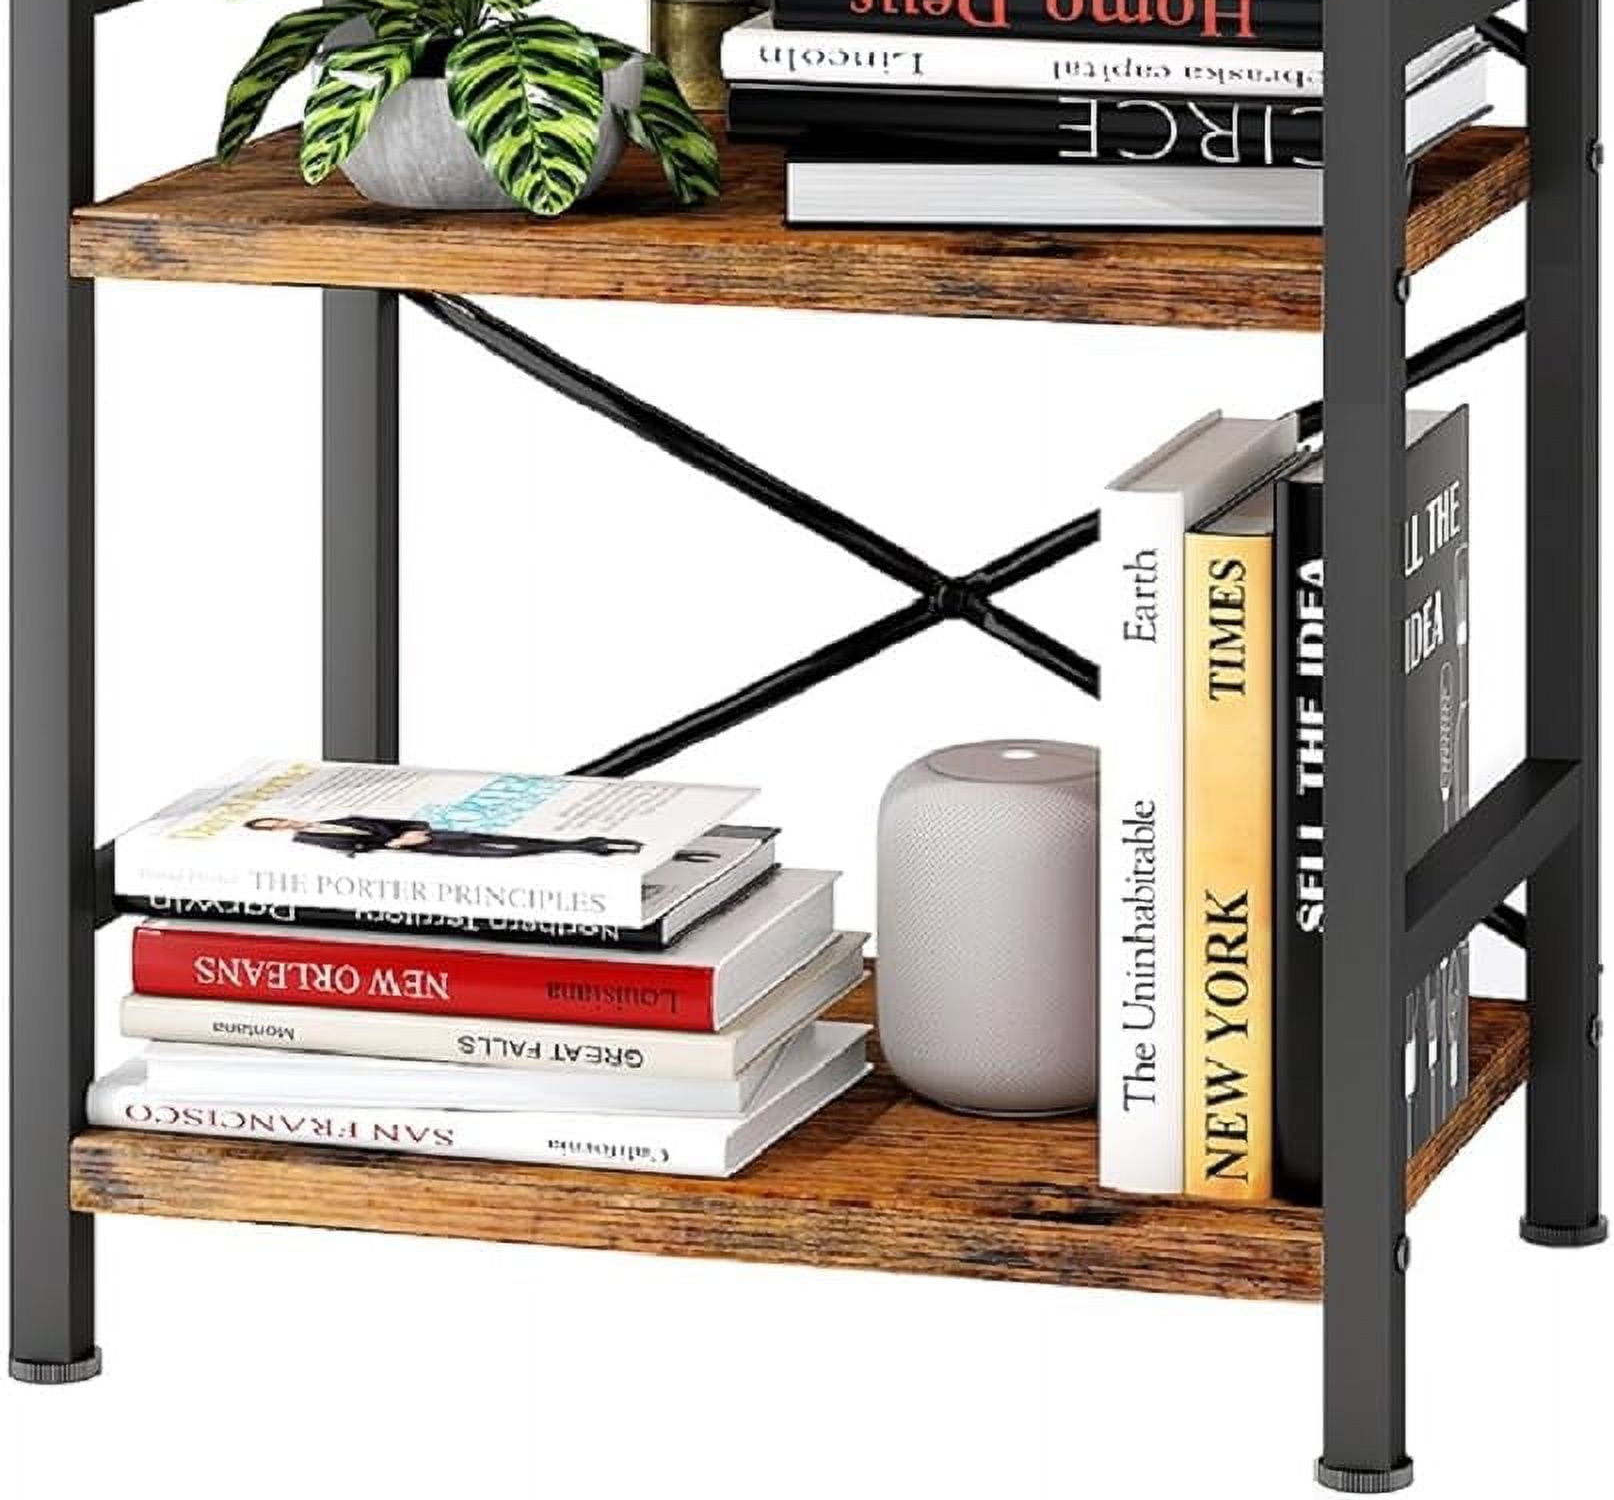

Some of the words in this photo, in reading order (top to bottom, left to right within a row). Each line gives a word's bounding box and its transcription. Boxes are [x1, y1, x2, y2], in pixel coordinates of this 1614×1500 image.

[760, 45, 924, 76] Lincoln
[1053, 57, 1172, 83] capital
[1184, 65, 1324, 88] ebraska
[1425, 480, 1462, 555] THE
[1122, 548, 1159, 644] Earth
[1296, 557, 1325, 677] IDEA
[1208, 558, 1248, 702] TIMES
[1404, 588, 1445, 677] IDEA
[1296, 696, 1325, 796] THE
[249, 869, 307, 895] THE
[316, 875, 428, 902] PORTER
[436, 882, 607, 913] PRINCIPLES
[1120, 799, 1157, 1031] Uninhabitable
[194, 955, 362, 995] ORLEANS
[367, 967, 450, 1001] NEW
[1204, 888, 1250, 1045] YORK
[546, 981, 680, 1015] Louisiana
[212, 1021, 296, 1041] Montana
[457, 1035, 541, 1060] FALLS
[550, 1043, 644, 1069] GREAT
[1121, 1042, 1157, 1112] The
[125, 1104, 358, 1138] FRANCISCO
[373, 1122, 455, 1146] SAN
[1204, 1055, 1249, 1184] NEW
